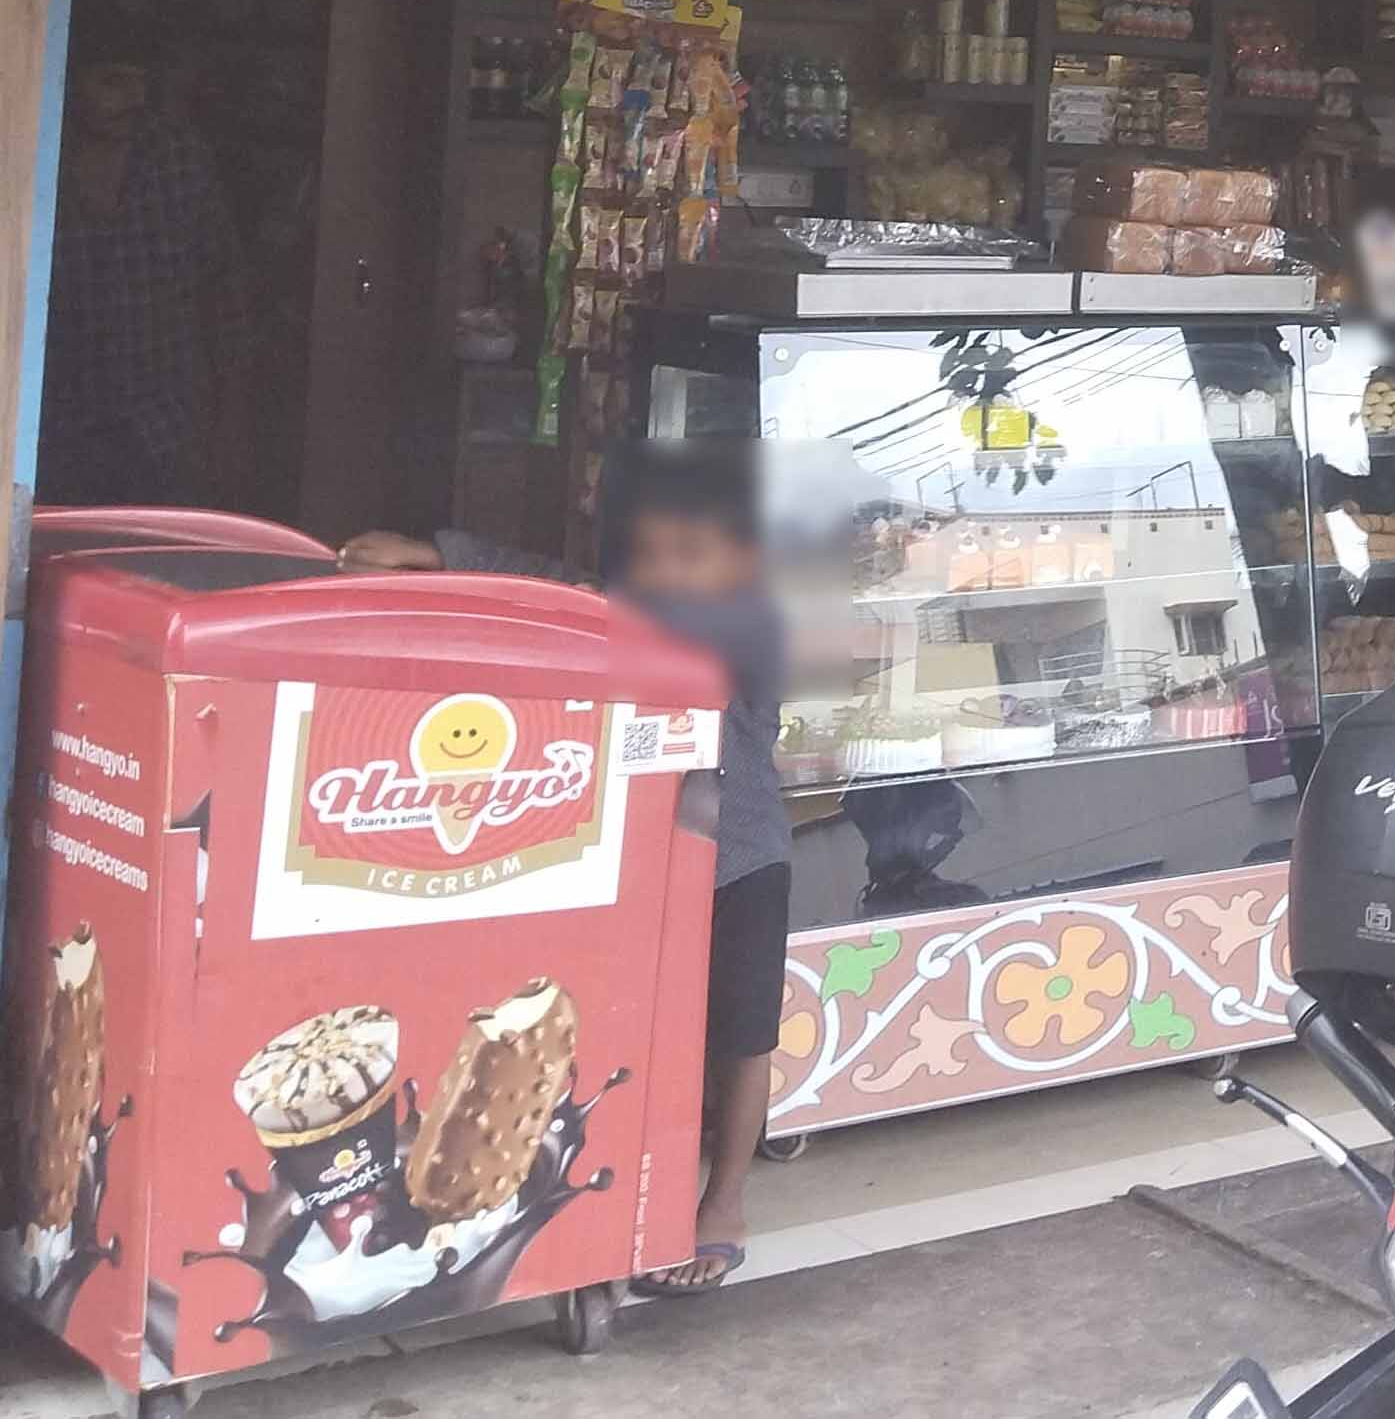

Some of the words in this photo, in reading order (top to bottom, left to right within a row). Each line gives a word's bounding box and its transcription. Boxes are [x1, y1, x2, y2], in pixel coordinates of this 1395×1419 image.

[51, 729, 141, 781] www.hangyo.in
[48, 774, 145, 838] hangyoicecream
[317, 757, 585, 822] Hangyo
[46, 823, 148, 892] hangyoicecreams
[367, 868, 416, 891] ICE
[426, 856, 522, 896] CREAM
